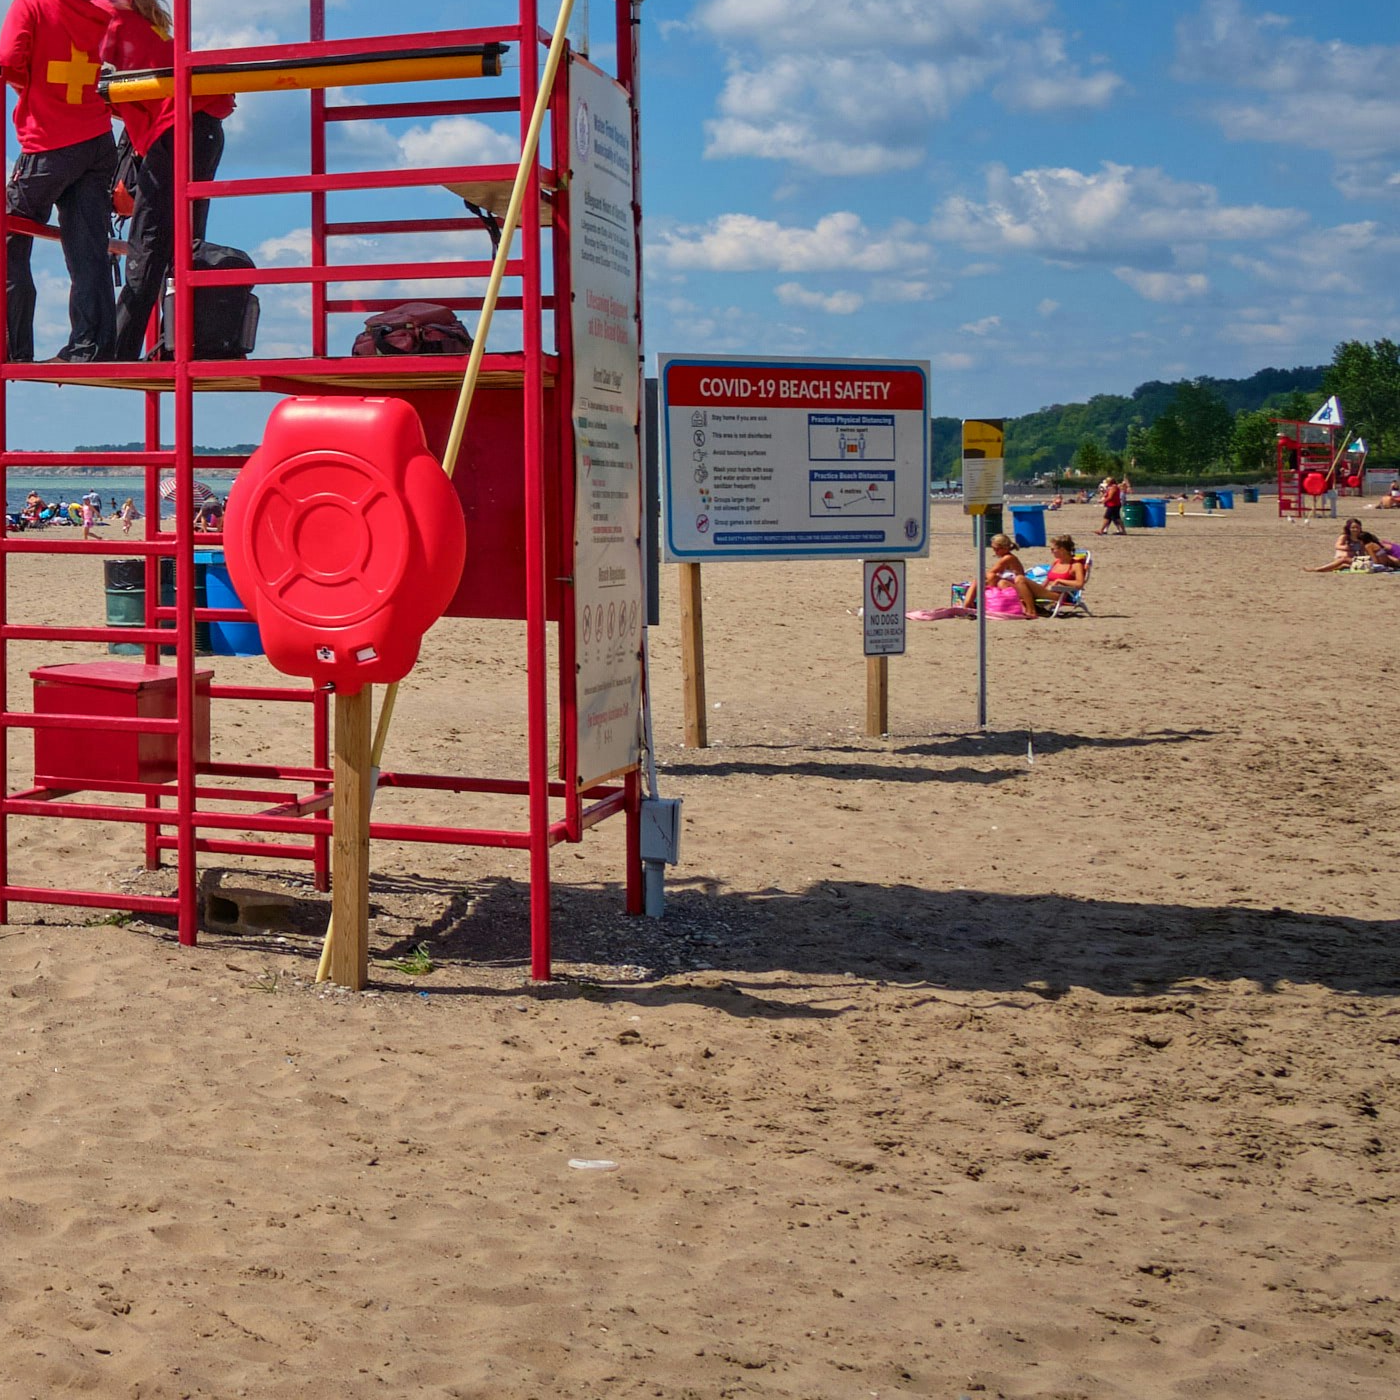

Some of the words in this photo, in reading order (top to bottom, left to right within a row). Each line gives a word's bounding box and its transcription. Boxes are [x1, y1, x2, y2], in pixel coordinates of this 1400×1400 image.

[700, 377, 776, 398] COVID-19
[779, 379, 831, 399] BEACH
[834, 380, 891, 401] SAFETY
[711, 414, 722, 422] Stay
[837, 416, 861, 426] Physical
[861, 417, 892, 426] Distancing
[814, 472, 838, 480] Practice
[839, 472, 857, 480] Beach
[858, 472, 888, 481] Distancing
[731, 496, 744, 504] larger
[870, 614, 880, 625] NO
[881, 613, 899, 625] DOGS
[890, 627, 904, 635] BEACH
